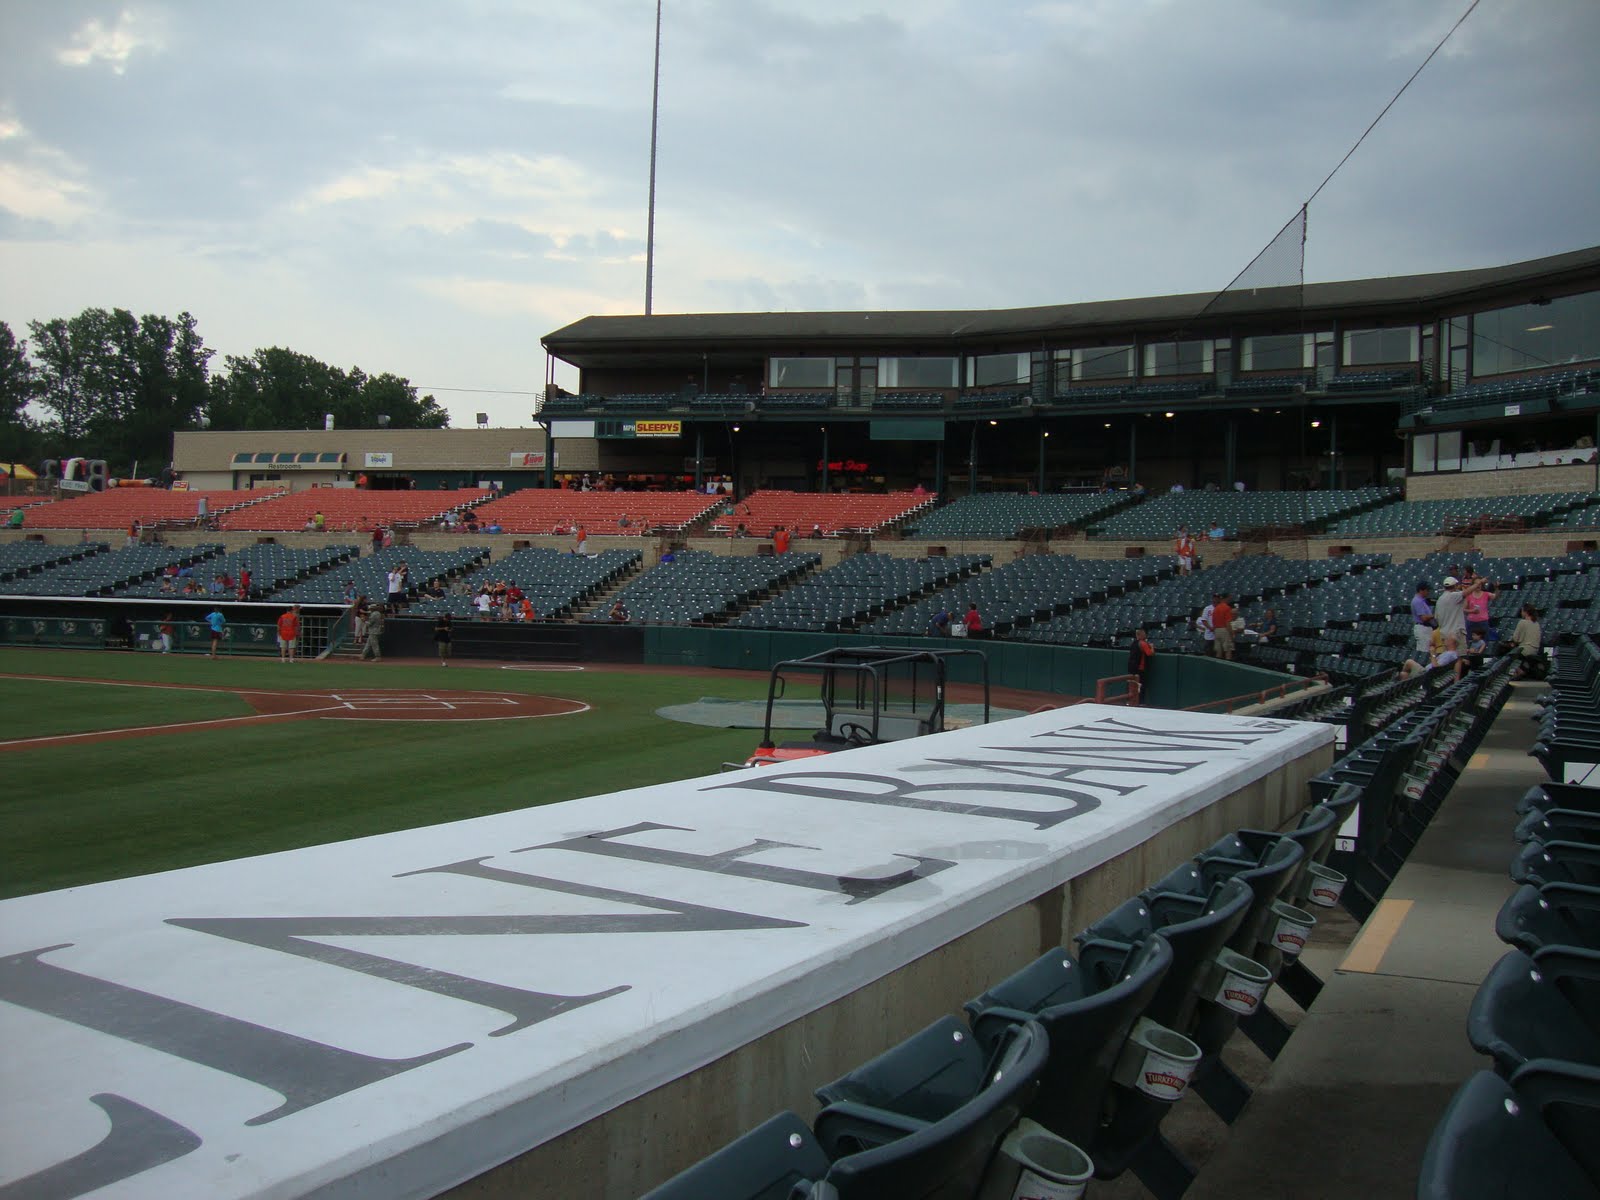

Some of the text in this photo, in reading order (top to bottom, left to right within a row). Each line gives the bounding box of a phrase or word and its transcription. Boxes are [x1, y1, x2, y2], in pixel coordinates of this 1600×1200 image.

[623, 424, 636, 432] MPH
[1341, 840, 1348, 851] C
[0, 717, 1286, 1200] INE BANK
[1147, 1073, 1174, 1085] TURKEY
